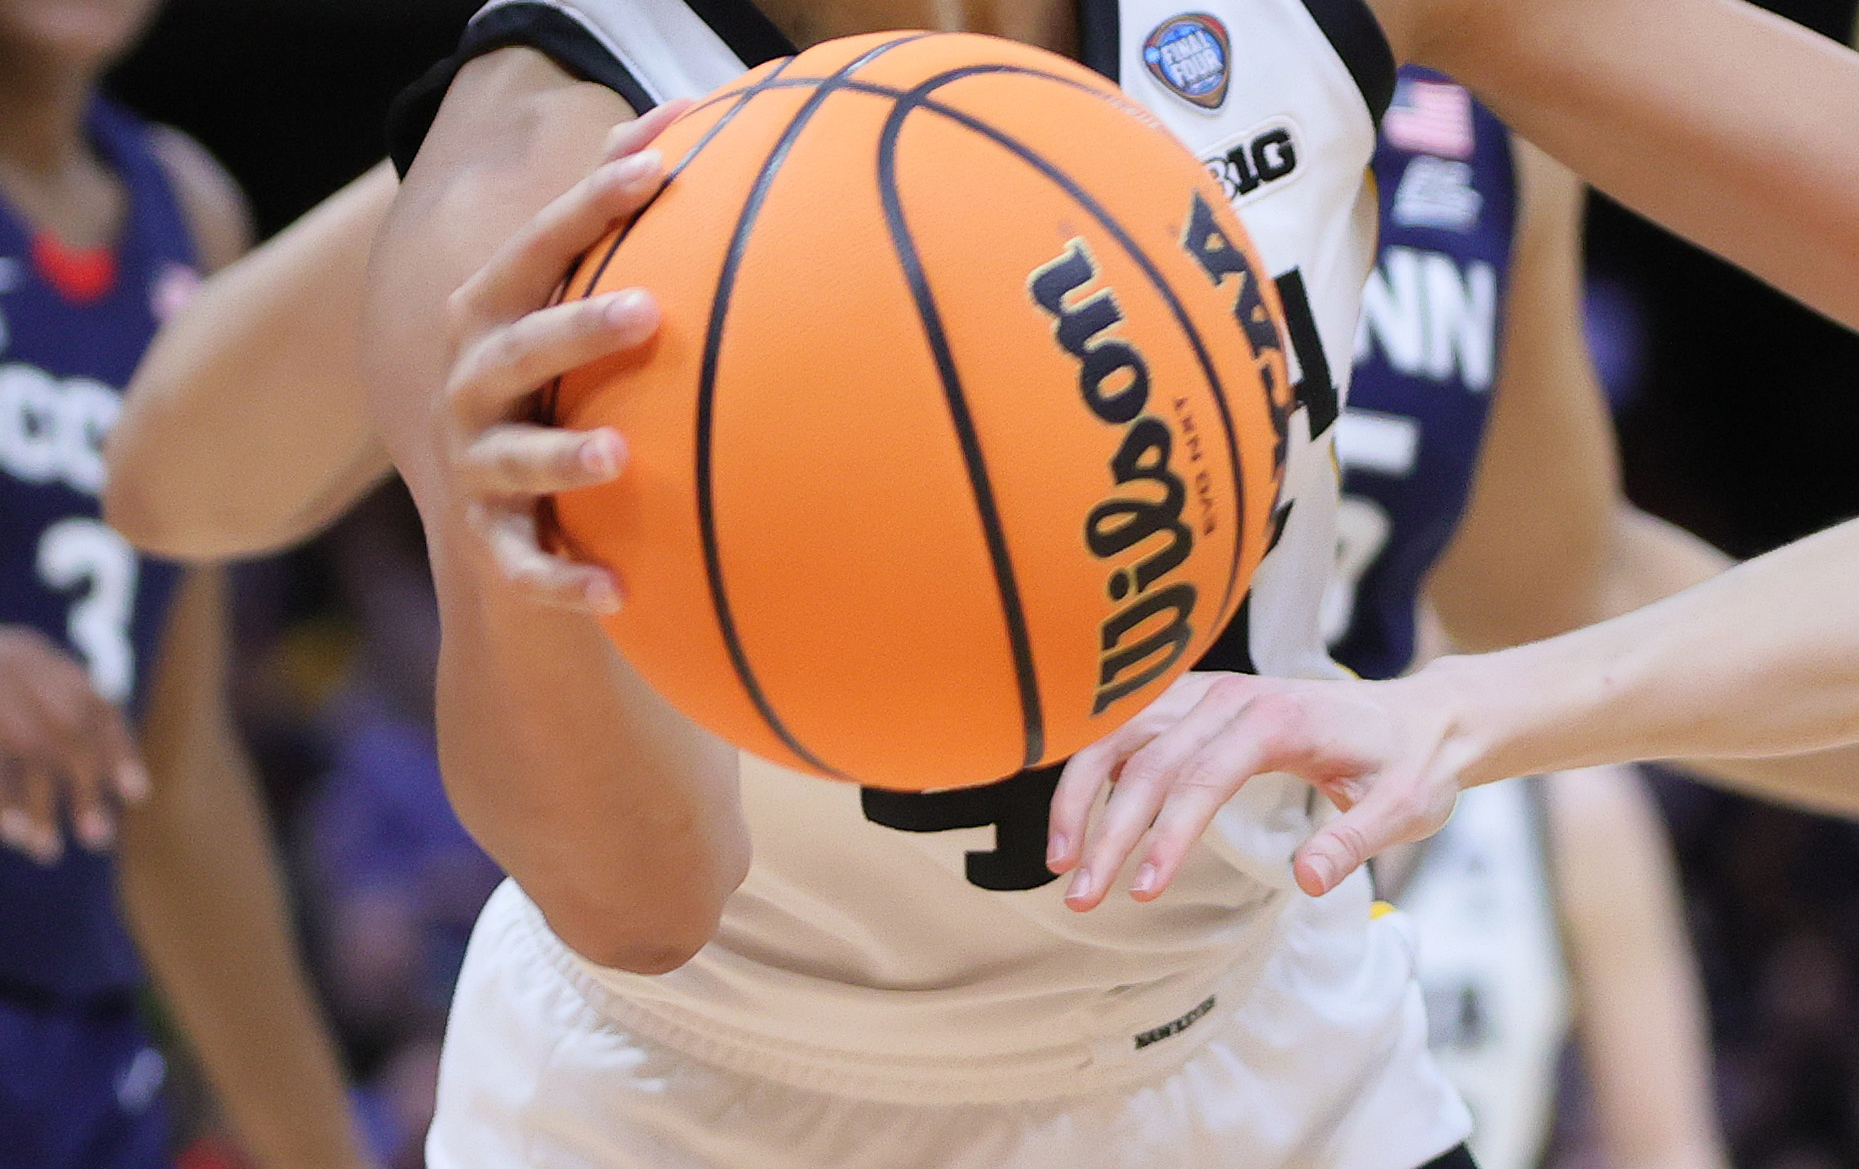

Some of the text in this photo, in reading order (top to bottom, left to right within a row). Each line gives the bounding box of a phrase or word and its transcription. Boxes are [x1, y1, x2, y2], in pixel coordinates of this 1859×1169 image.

[1160, 29, 1212, 66] FINAL
[1169, 48, 1225, 89] FOUR
[1026, 234, 1198, 719] Wilson
